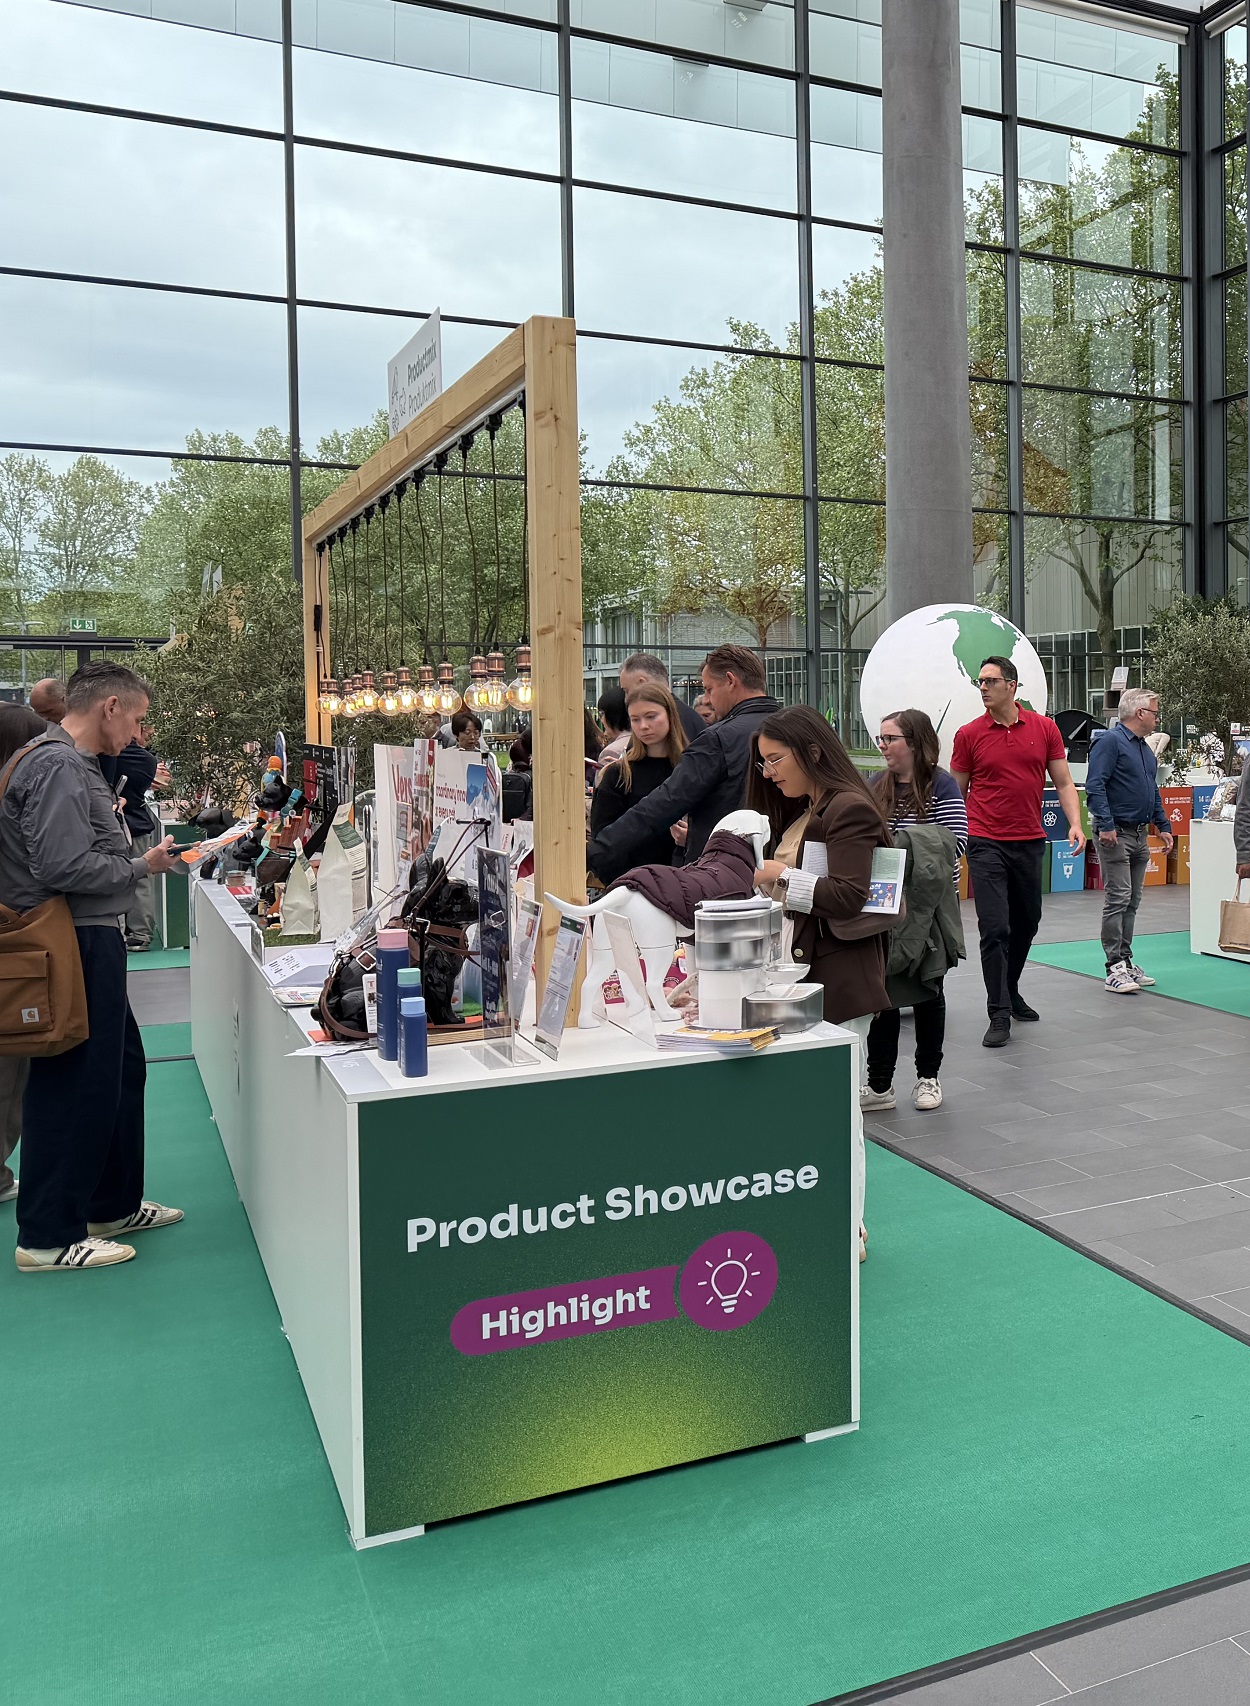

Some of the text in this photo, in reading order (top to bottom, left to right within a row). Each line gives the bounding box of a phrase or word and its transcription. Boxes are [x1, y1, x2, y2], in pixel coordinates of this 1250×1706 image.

[408, 338, 437, 386] Productmix
[406, 1164, 820, 1253] Product Showcase
[481, 1285, 652, 1340] Highlight
